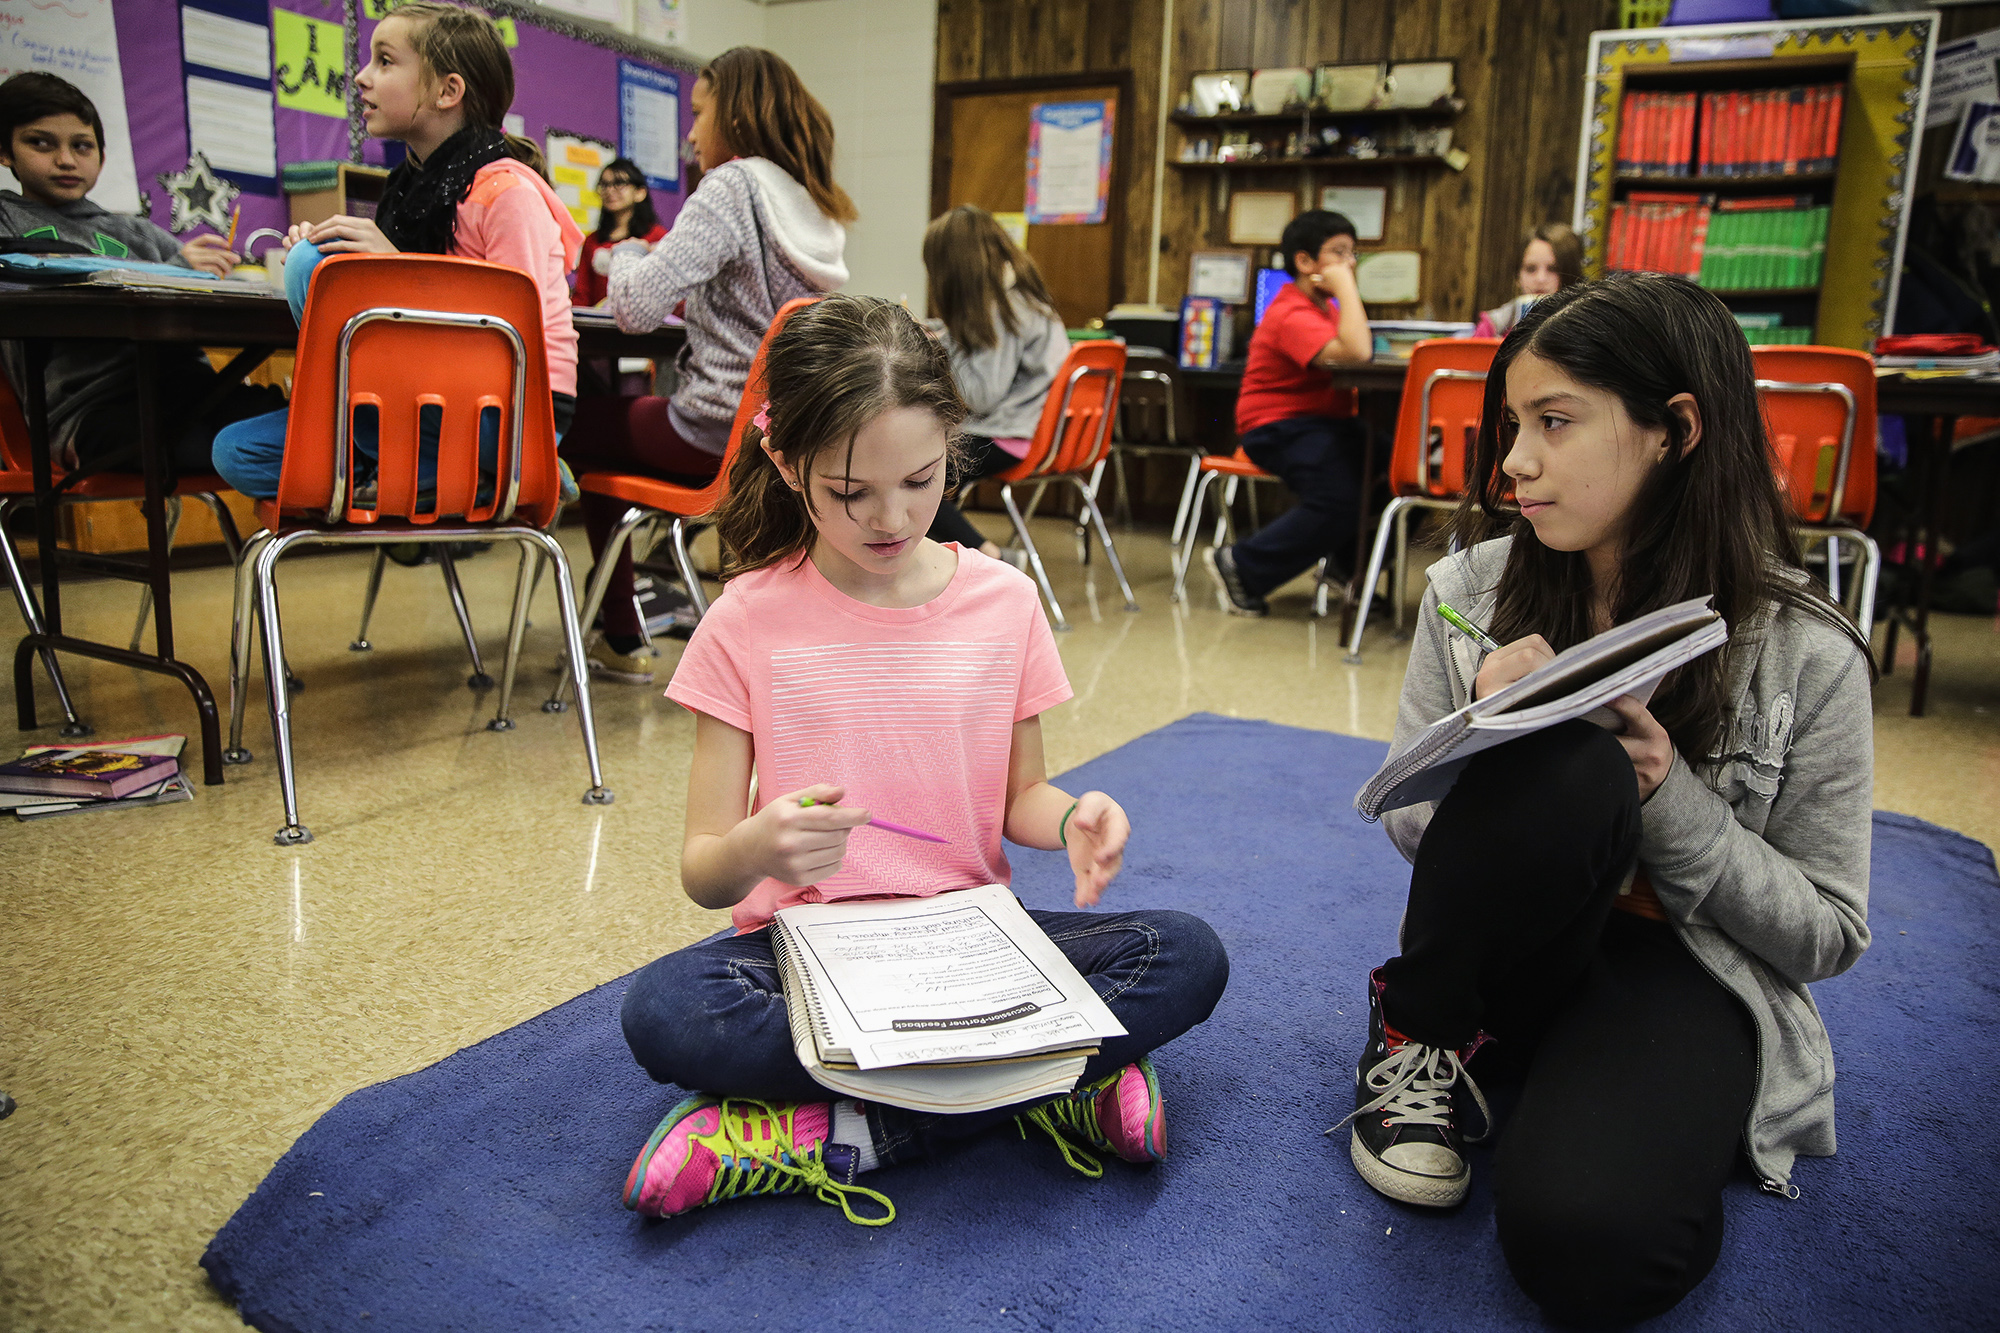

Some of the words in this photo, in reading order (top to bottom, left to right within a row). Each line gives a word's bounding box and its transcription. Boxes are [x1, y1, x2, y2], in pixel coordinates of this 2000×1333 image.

[306, 23, 318, 54] I
[276, 56, 345, 100] CAN
[948, 1004, 1036, 1027] Discussion-Partner
